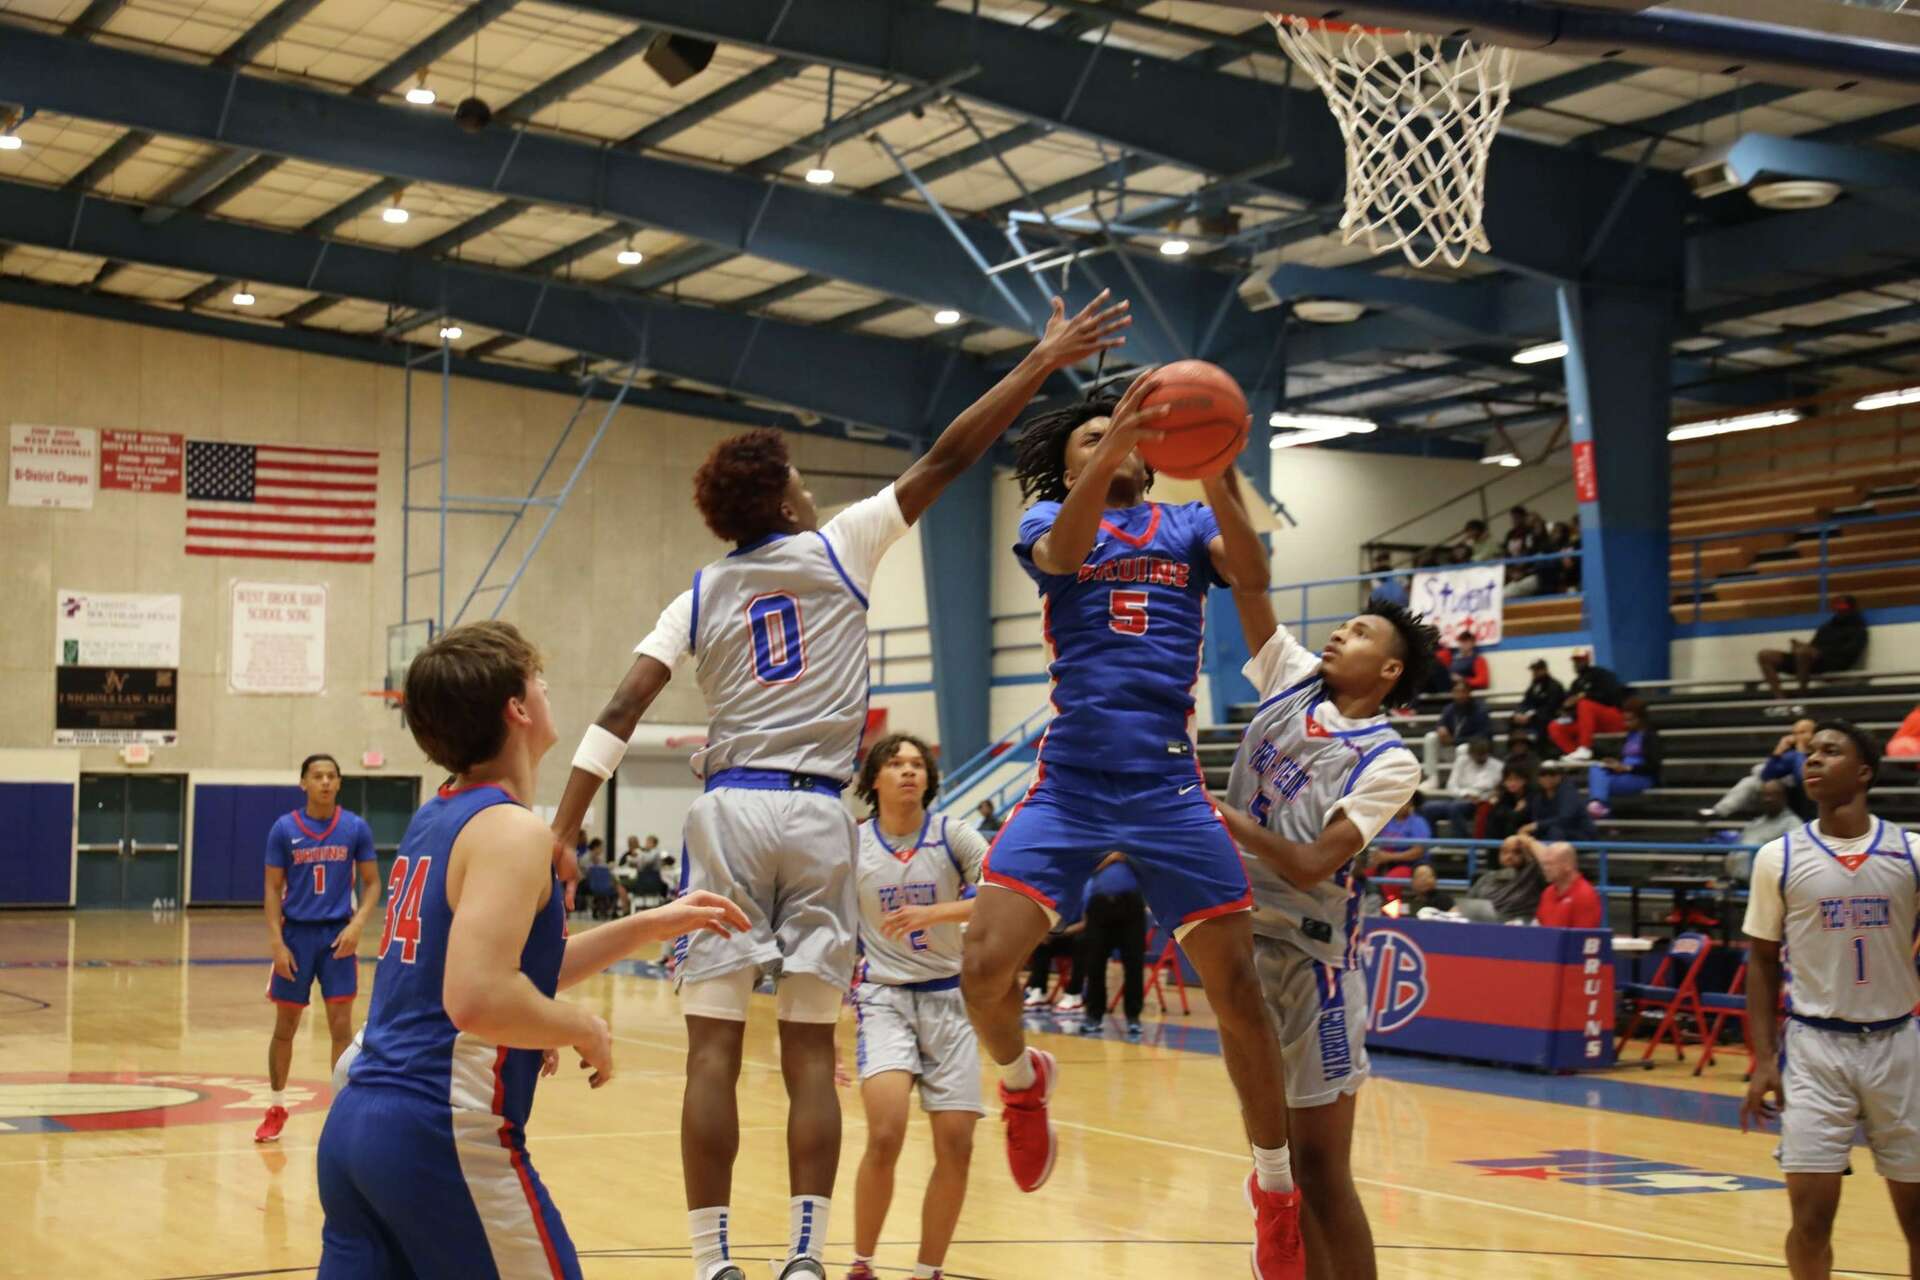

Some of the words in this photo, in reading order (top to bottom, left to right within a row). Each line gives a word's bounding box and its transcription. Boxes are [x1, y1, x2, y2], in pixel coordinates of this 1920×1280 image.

[746, 590, 808, 688] 0
[1109, 590, 1149, 636] 5
[313, 864, 326, 895] 1
[377, 856, 432, 964] 34
[1853, 936, 1870, 984] 1
[1583, 937, 1601, 1058] BRUINS
[1319, 1008, 1352, 1081] WARRIORS
